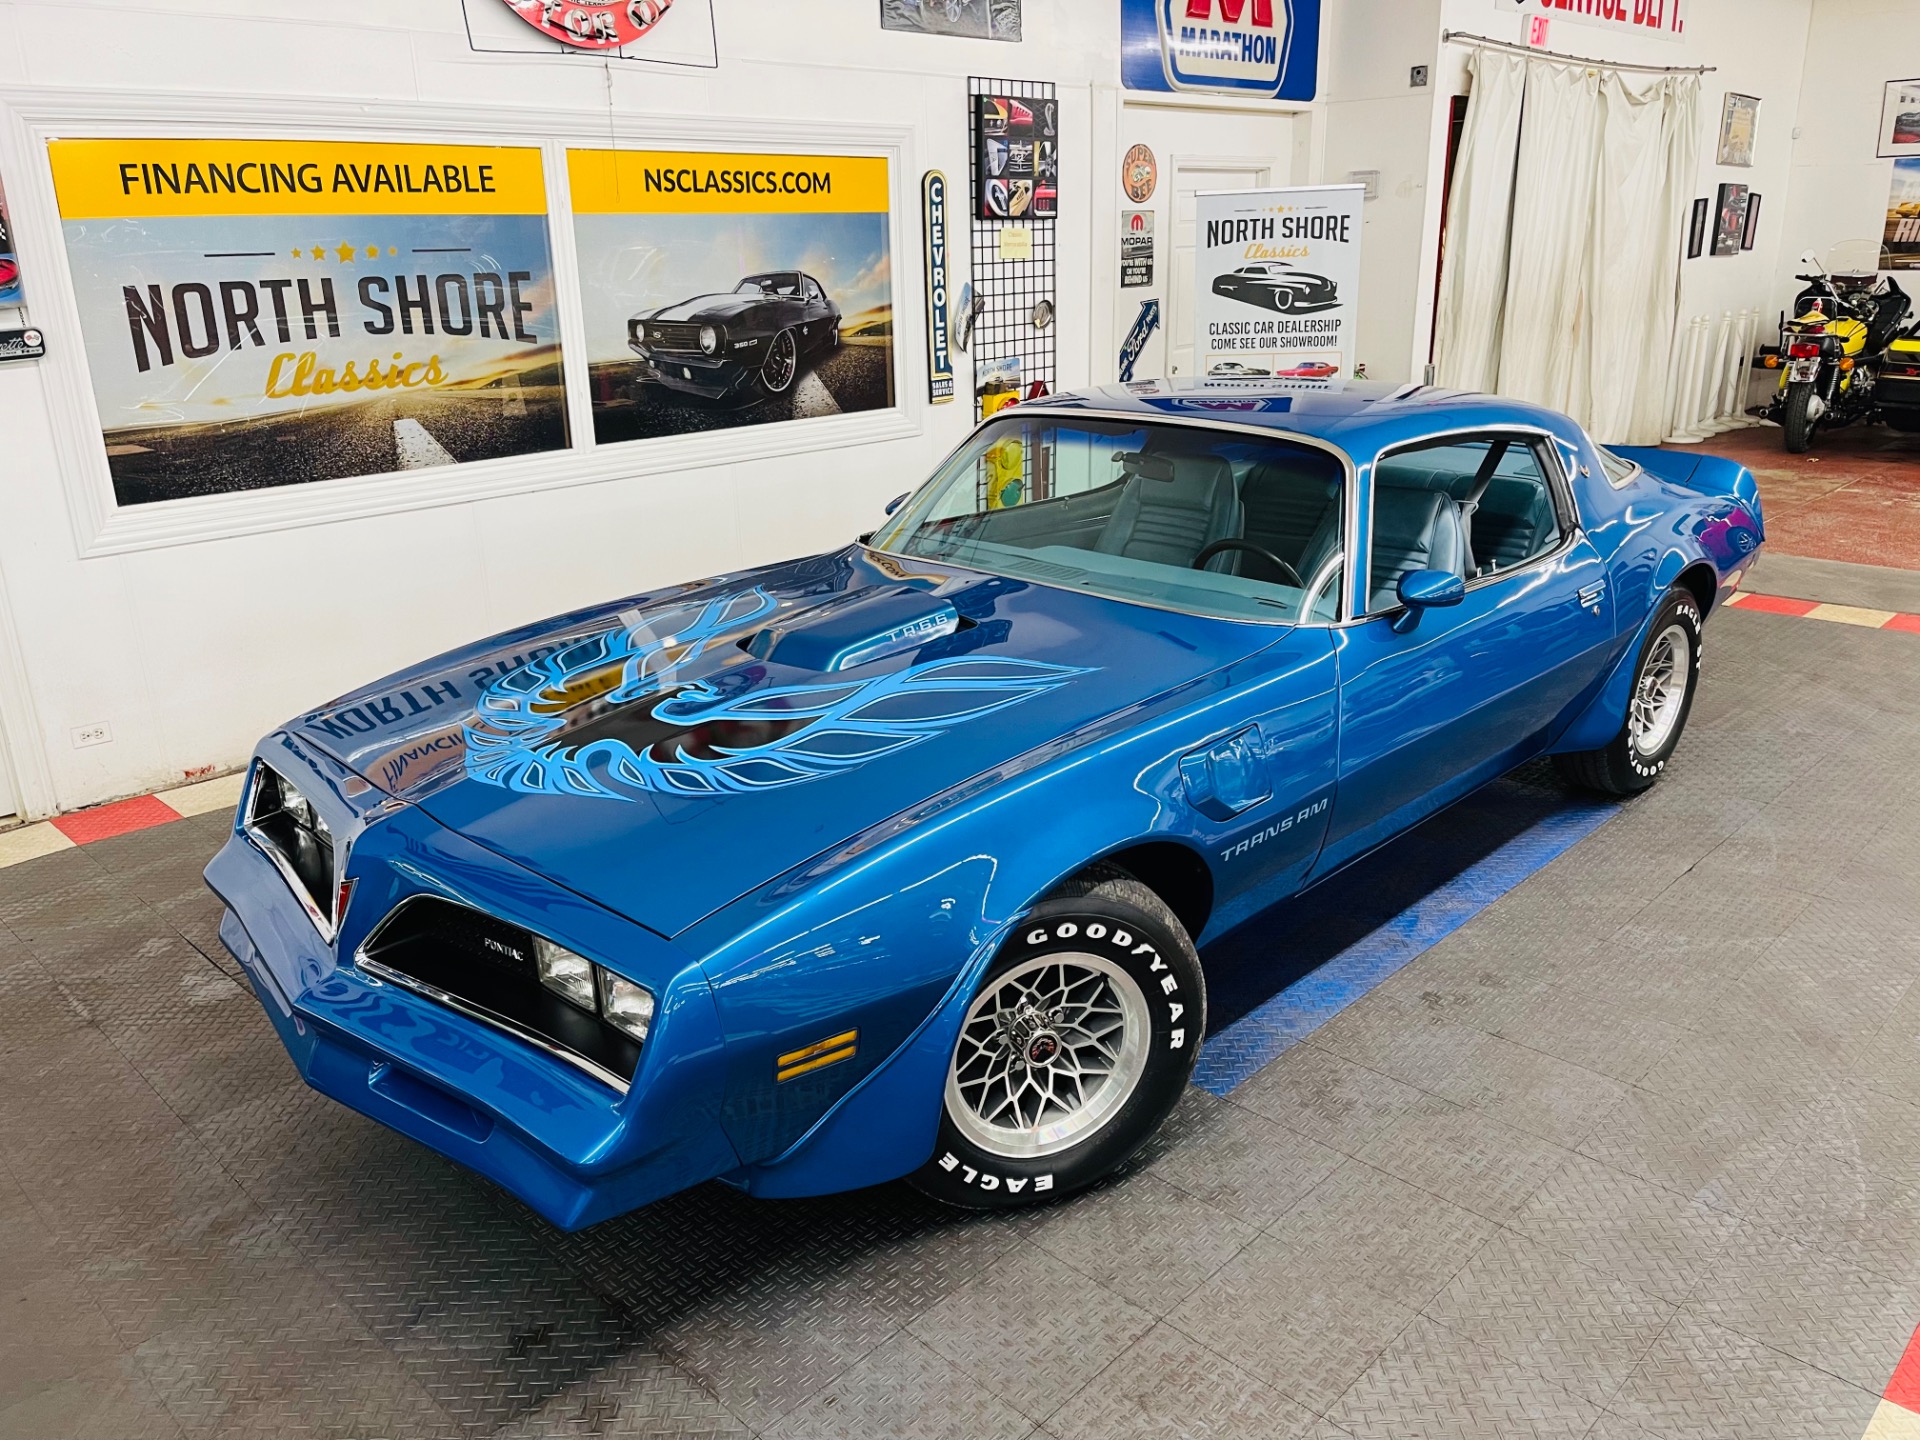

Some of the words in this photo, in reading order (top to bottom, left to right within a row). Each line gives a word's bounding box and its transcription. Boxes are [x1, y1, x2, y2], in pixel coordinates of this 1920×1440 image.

[512, 0, 620, 44] TOR
[1531, 16, 1549, 46] EXIT
[1179, 26, 1277, 64] MARATHON
[119, 163, 322, 194] FINANCING
[332, 165, 496, 193] AVAILABLE
[644, 168, 831, 194] NSCLASSICS.COM
[1130, 179, 1152, 199] BEE
[1121, 237, 1153, 246] MOPAR
[1207, 217, 1275, 248] NORTH
[1282, 215, 1350, 243] SHORE
[1892, 219, 1920, 243] RI
[1134, 258, 1147, 266] WITH
[1244, 243, 1310, 259] Classics
[930, 182, 948, 369] CHEVROLET
[122, 277, 342, 373] NORTH
[358, 271, 538, 345] SHORE
[1209, 322, 1251, 335] CLASSIC
[1253, 321, 1274, 334] CAR
[1277, 319, 1342, 333] DEALERSHIP
[1127, 320, 1150, 362] Ford
[1211, 338, 1237, 350] COME
[1239, 337, 1256, 349] SEE
[1259, 337, 1278, 348] OUR
[1280, 335, 1338, 348] SHOWROOM!
[265, 351, 449, 398] Classics
[932, 381, 948, 389] SALES
[932, 387, 953, 396] SERVICE
[1676, 605, 1700, 635] EAGLE
[1220, 816, 1294, 862] TRANS
[1296, 798, 1328, 824] AM
[484, 937, 524, 962] PONTIAC
[1026, 922, 1185, 1050] GOODYEAR
[938, 1151, 1054, 1194] EAGLE
